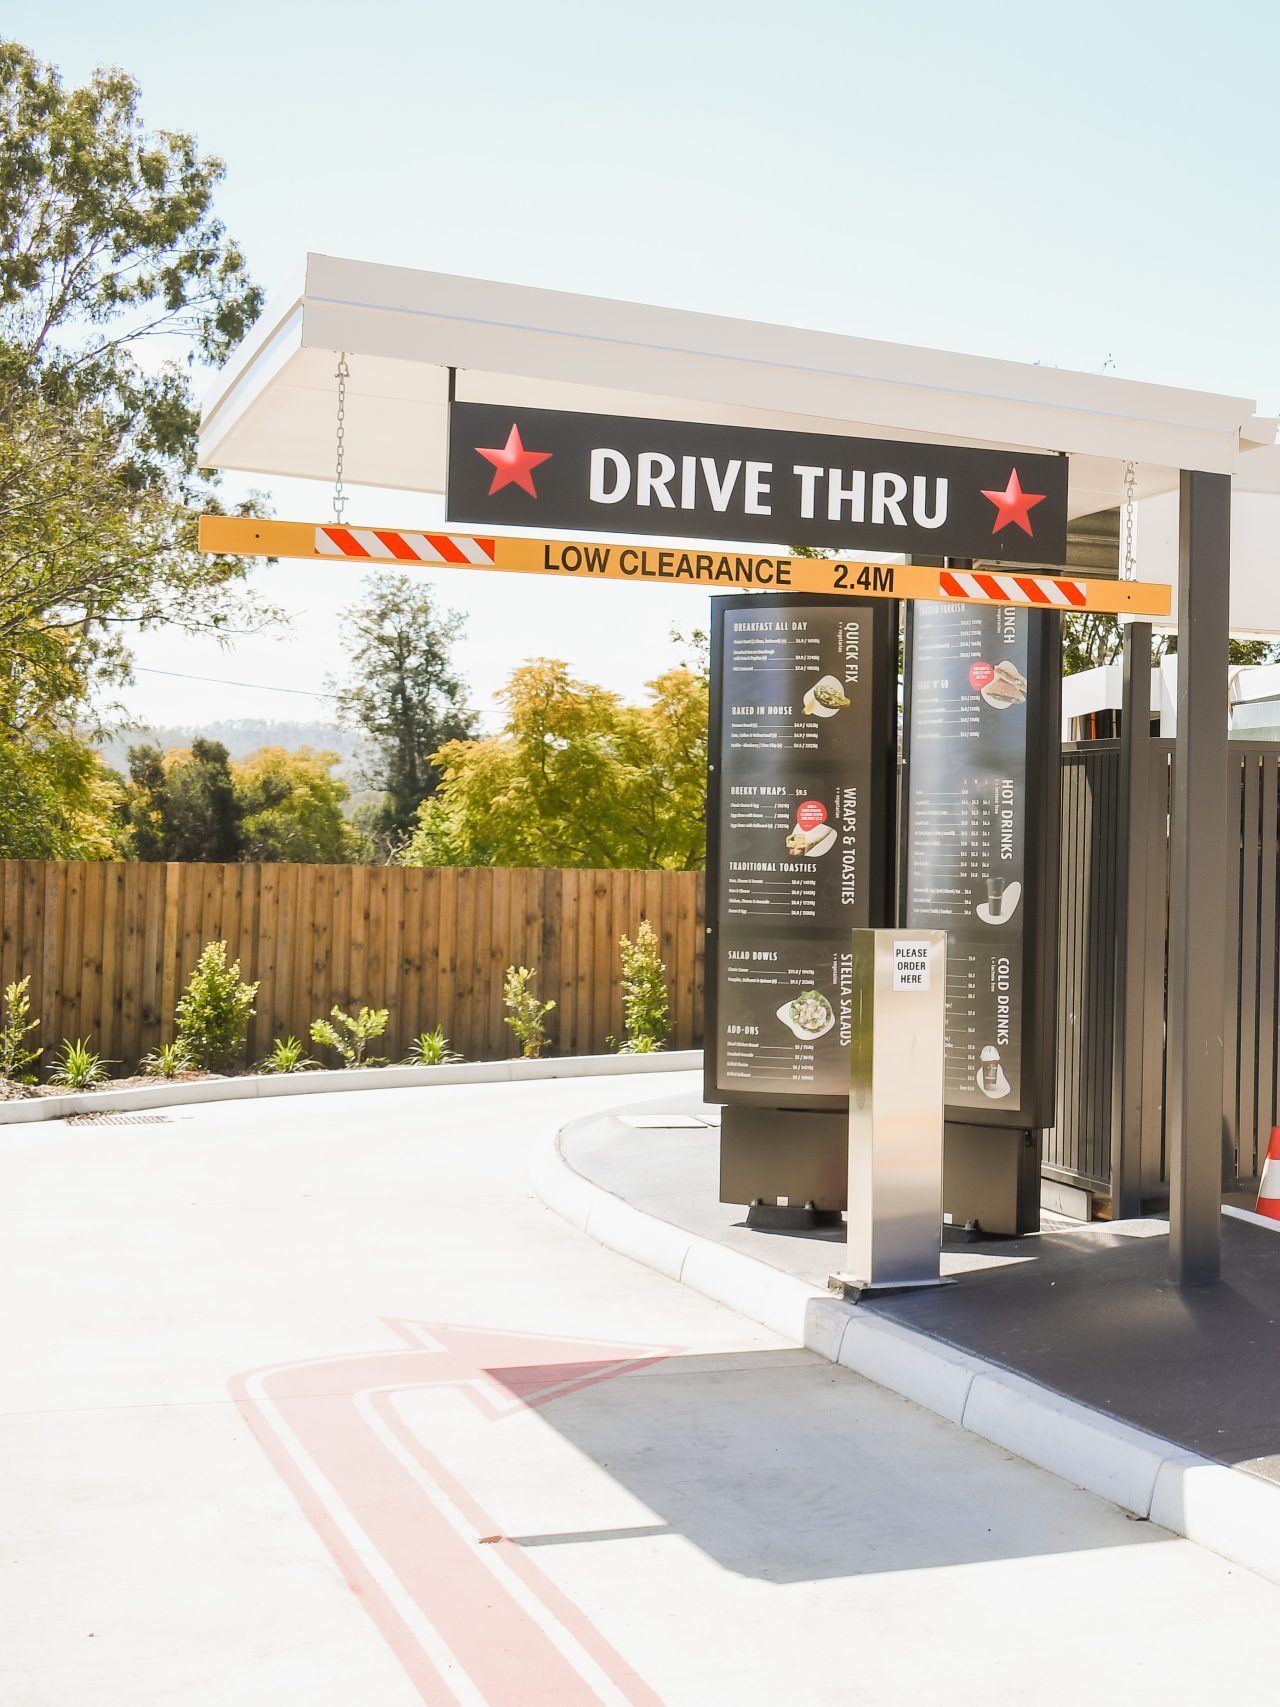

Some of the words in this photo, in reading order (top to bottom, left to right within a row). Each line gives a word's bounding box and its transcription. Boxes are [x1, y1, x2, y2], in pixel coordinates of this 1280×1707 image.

[589, 447, 773, 516] DRIVE
[793, 464, 949, 529] THRU
[544, 544, 611, 573] LOW
[619, 549, 792, 585] CLEARANCE
[833, 564, 895, 593] 2.4M
[734, 622, 773, 632] BREAKFAST
[775, 622, 789, 631] ALL
[792, 622, 808, 630] DAY
[1004, 606, 1015, 644] UNCH
[844, 622, 860, 660] QUICK
[845, 664, 859, 683] FIX
[732, 706, 754, 715] BAKED
[756, 706, 765, 715] IN
[768, 706, 793, 715] HOUSE
[730, 786, 758, 796] BREKKY
[760, 787, 787, 796] WRAPS
[1002, 780, 1014, 806] HOT
[842, 788, 857, 832] WRAPS
[843, 836, 856, 845] &
[1001, 810, 1013, 860] DRINKS
[729, 862, 776, 872] TRADITIONAL
[780, 863, 817, 873] TOASTIES
[841, 849, 856, 905] TOASTIES
[728, 951, 750, 960] SALAD
[752, 952, 778, 961] BOWLS
[896, 949, 928, 958] PLEASE
[898, 962, 926, 970] ORDER
[840, 954, 852, 996] STELLA
[901, 975, 922, 984] HERE
[997, 958, 1010, 991] COLD
[727, 1025, 759, 1035] ADD-ONS
[840, 1000, 852, 1046] SALADS
[997, 996, 1009, 1046] DRINKS
